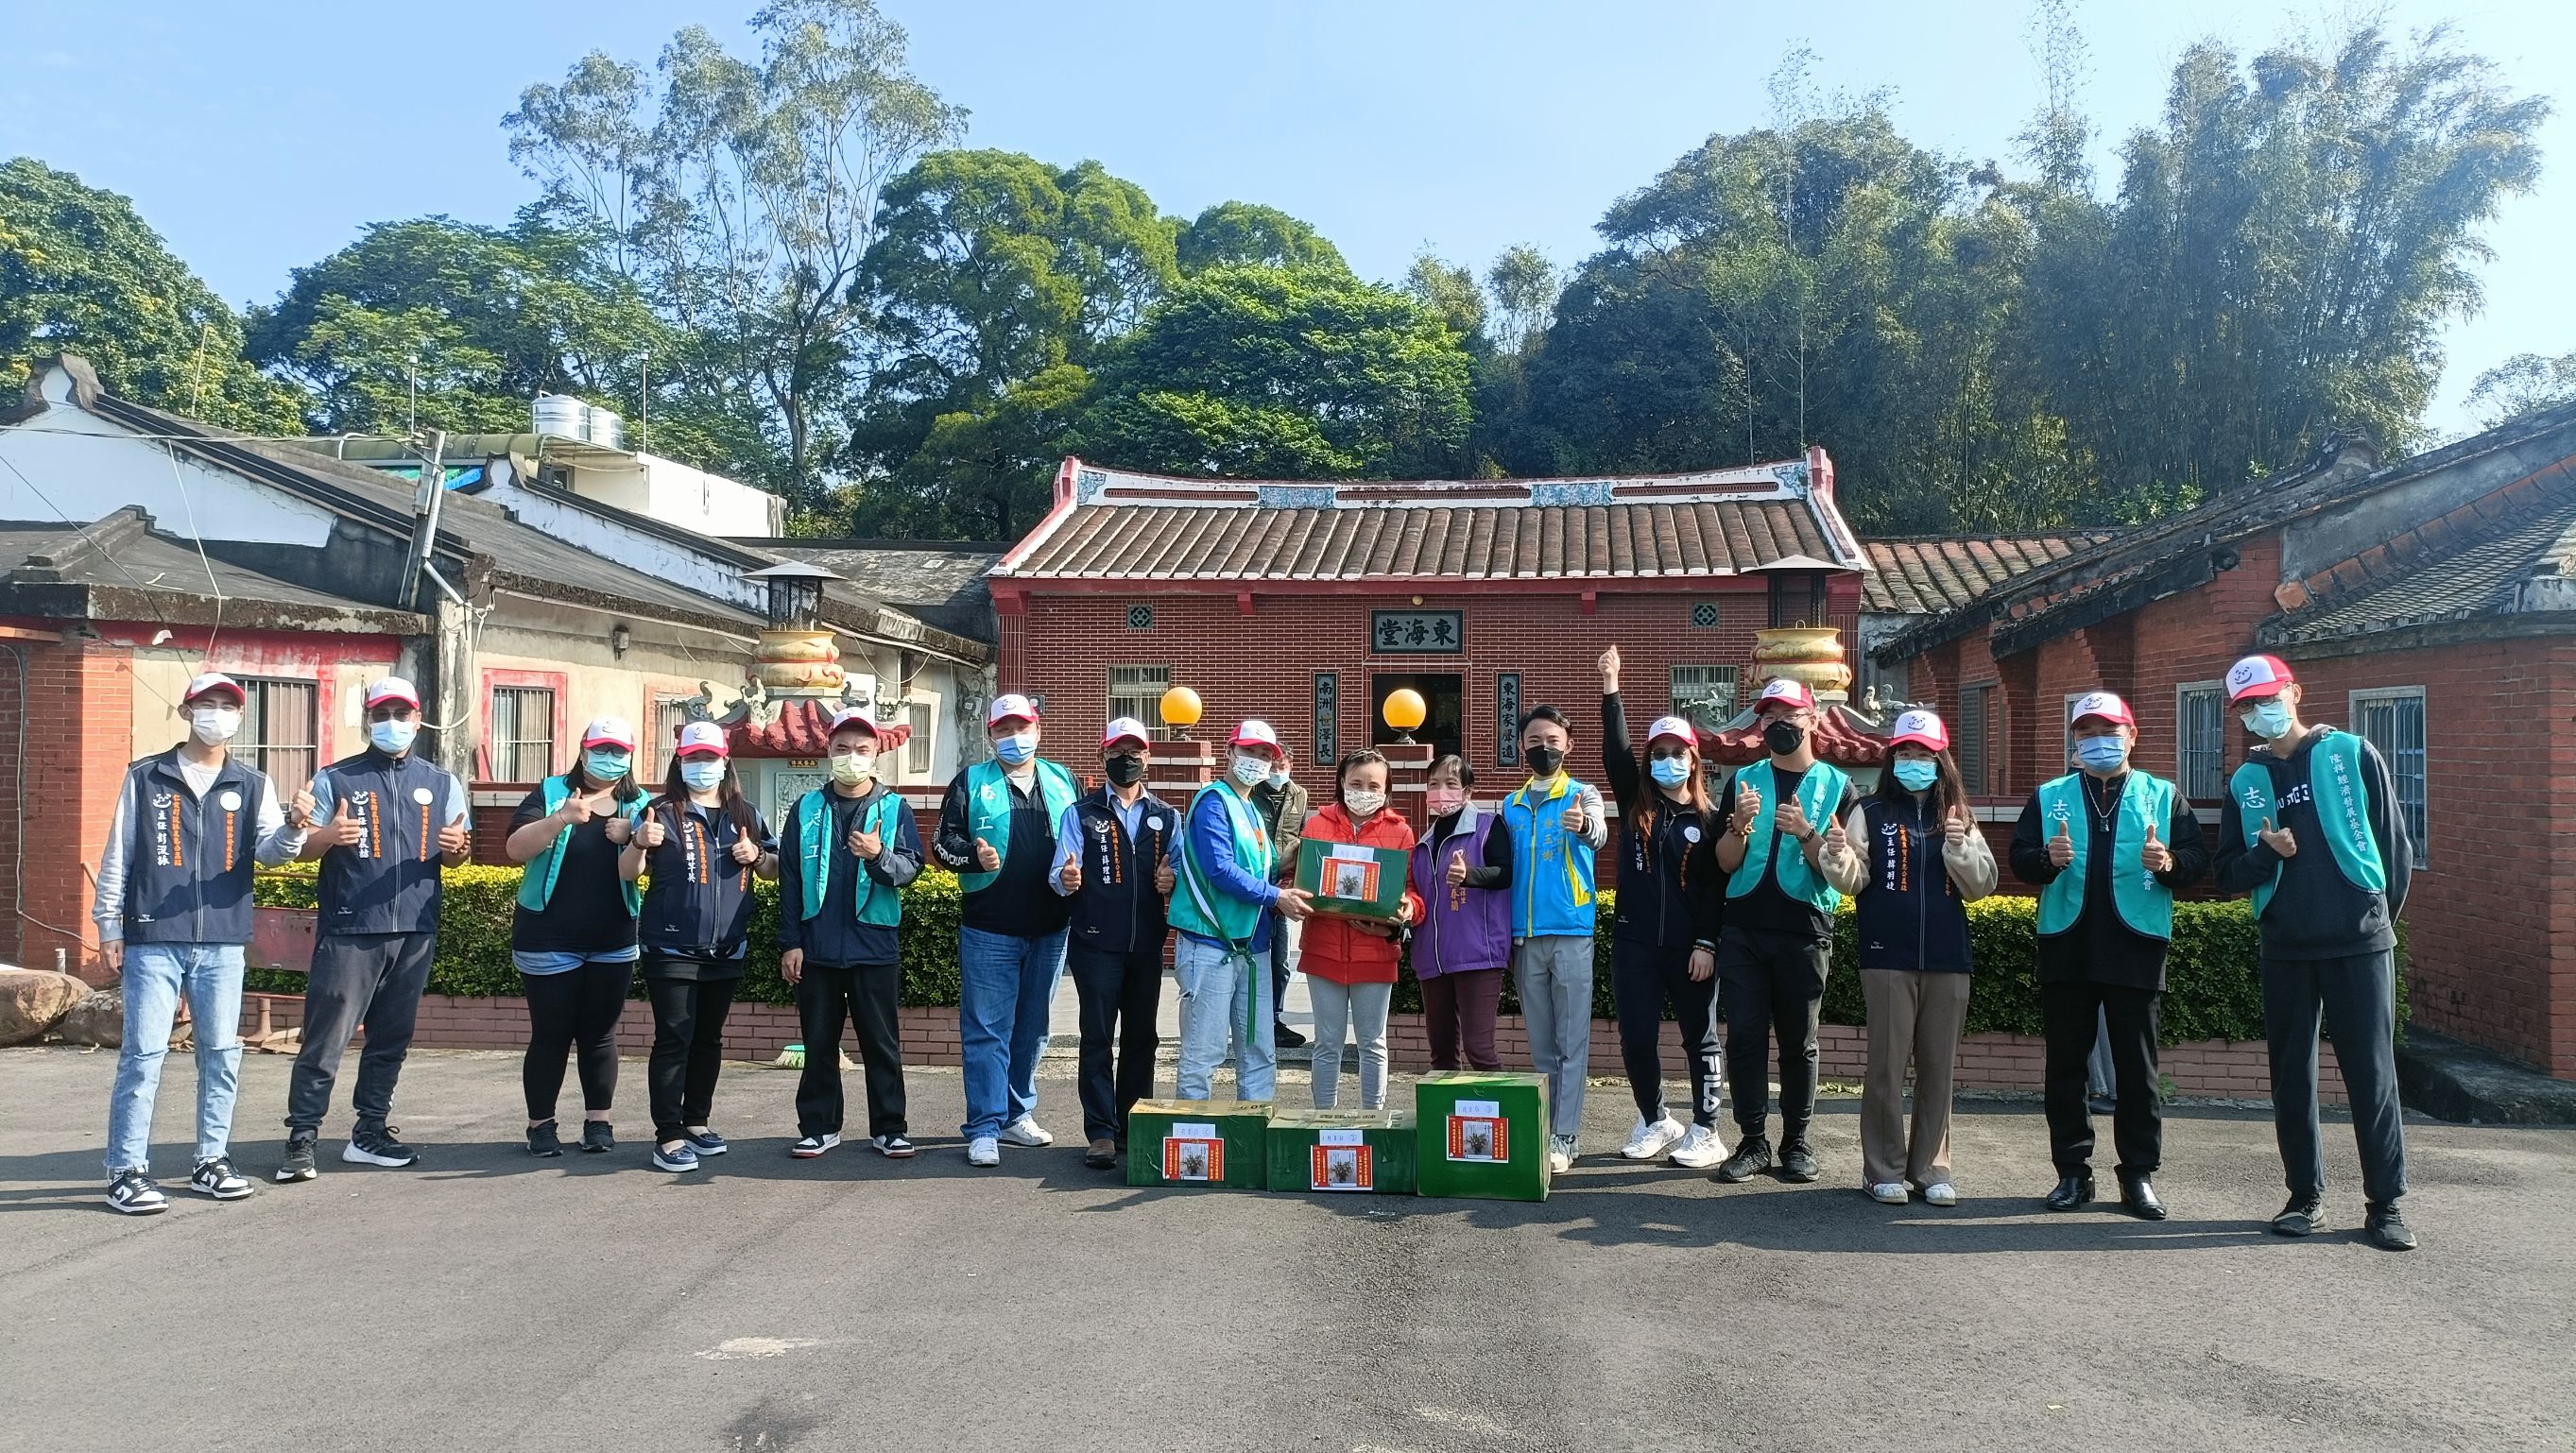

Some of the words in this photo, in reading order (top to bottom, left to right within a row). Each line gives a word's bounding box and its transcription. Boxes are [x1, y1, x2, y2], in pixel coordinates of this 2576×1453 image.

[1379, 618, 1456, 646] 東海堂
[2329, 754, 2366, 851] 隆祥經濟發展基金會
[1702, 1055, 1721, 1113] FILA
